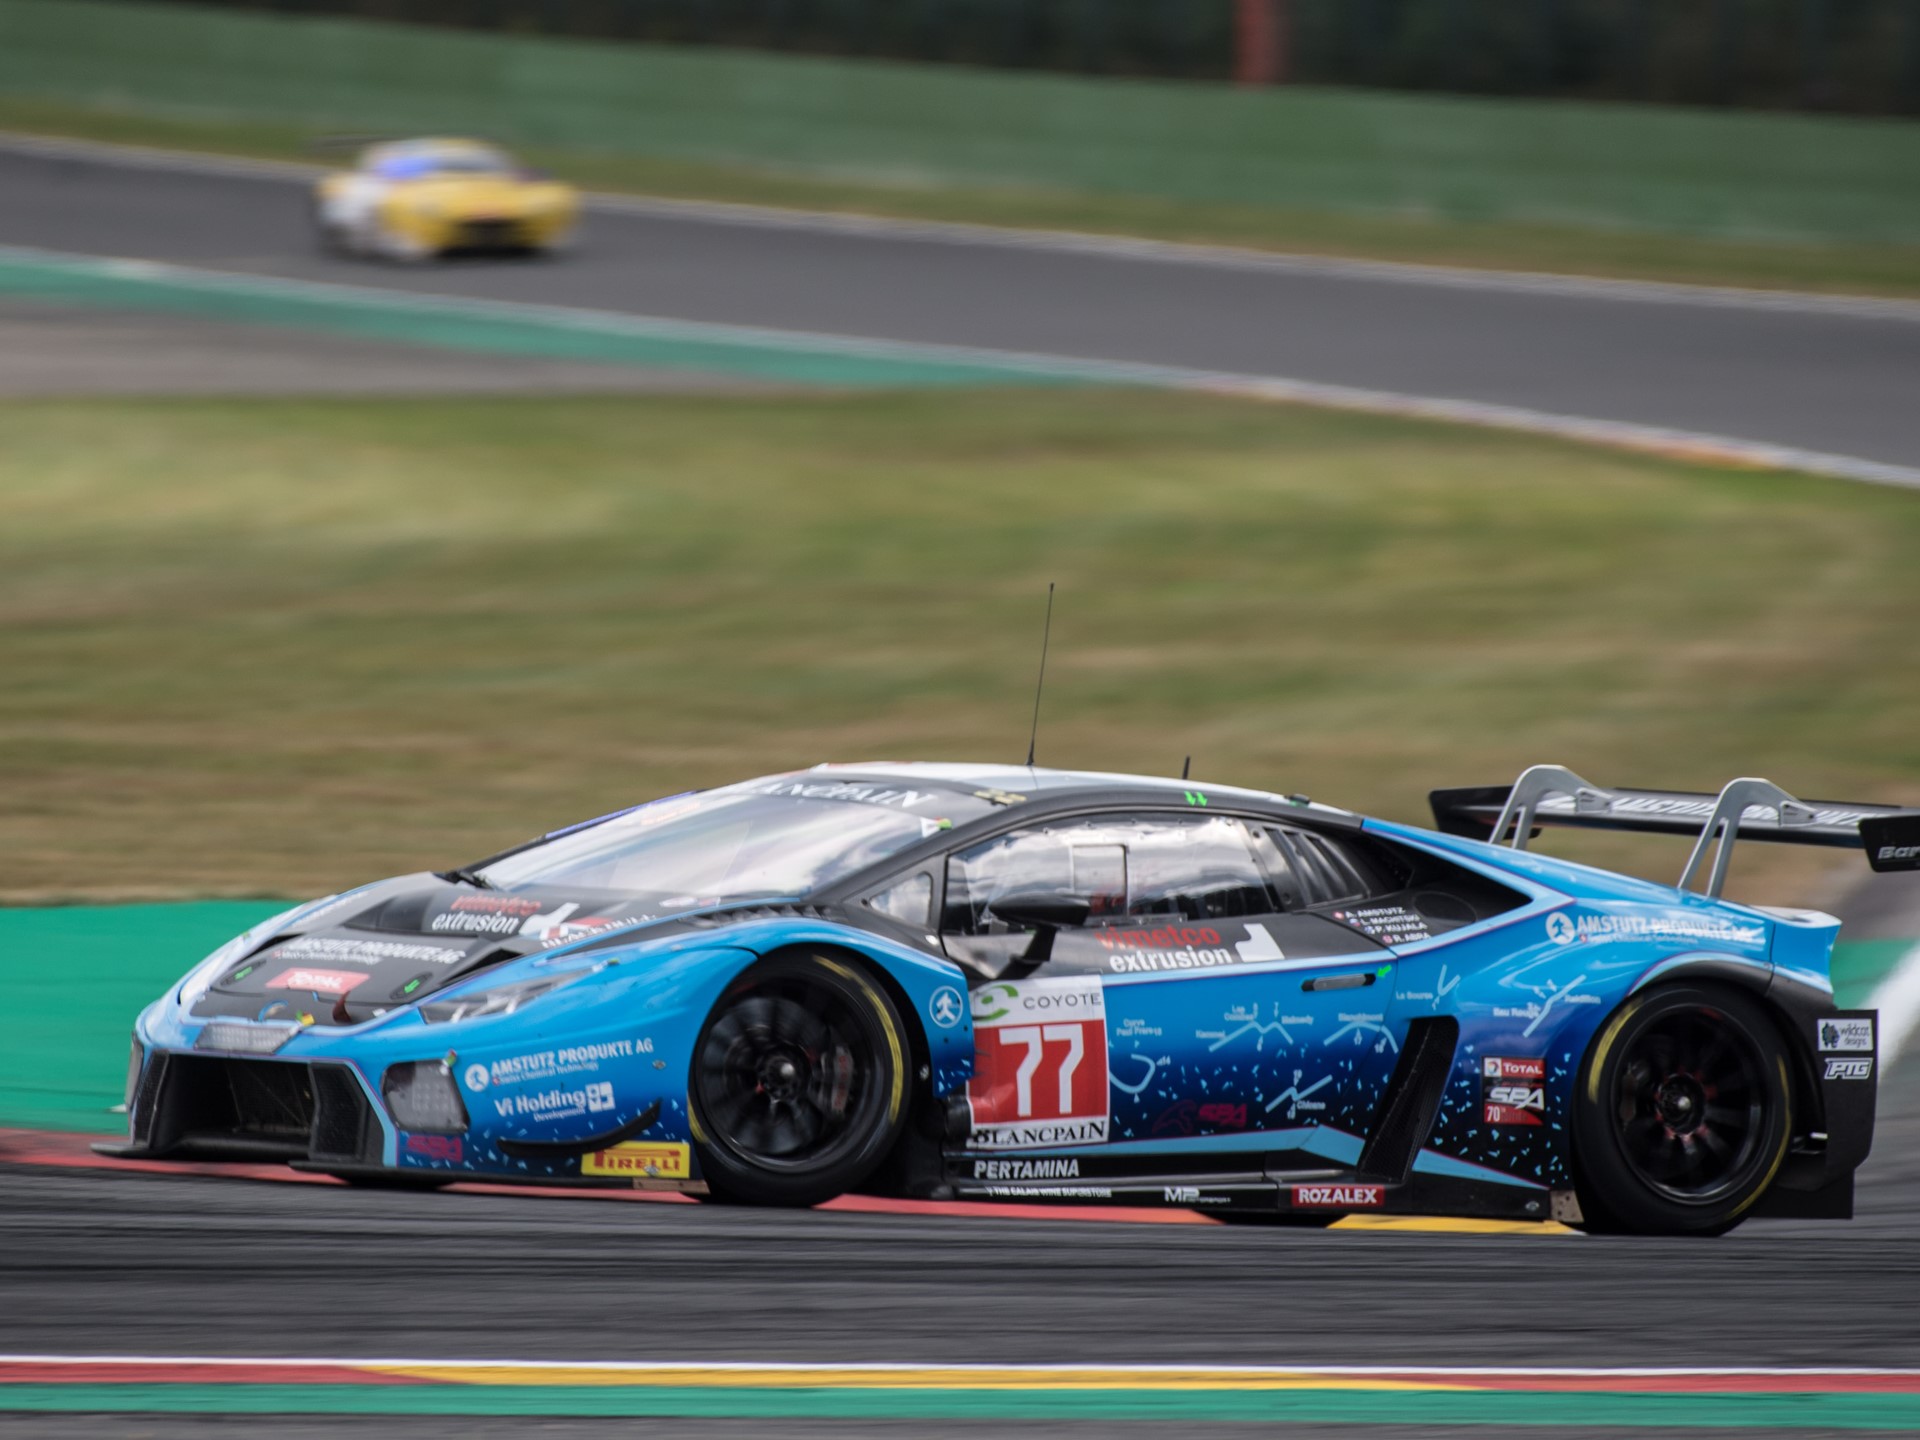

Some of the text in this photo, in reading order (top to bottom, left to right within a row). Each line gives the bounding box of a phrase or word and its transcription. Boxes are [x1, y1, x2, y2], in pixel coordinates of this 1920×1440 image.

[431, 910, 519, 934] extrusion
[1357, 907, 1406, 917] AMSTUTZ
[1577, 915, 1649, 934] AMSTUTZ
[1094, 924, 1221, 950] vimetco
[1109, 945, 1233, 973] extrusion
[1023, 993, 1102, 1010] COYOTE
[491, 1037, 654, 1077] AMSTUTZ PRODUKTE AG
[1503, 1061, 1543, 1074] TOTAL
[999, 1023, 1084, 1117] 77
[494, 1089, 587, 1117] Vi Holding
[1489, 1087, 1545, 1110] SPA
[973, 1120, 1105, 1145] BLANCPAIN
[594, 1149, 680, 1172] PIRELLI
[973, 1158, 1080, 1179] PERTAMINA
[1299, 1188, 1377, 1204] ROZALEX
